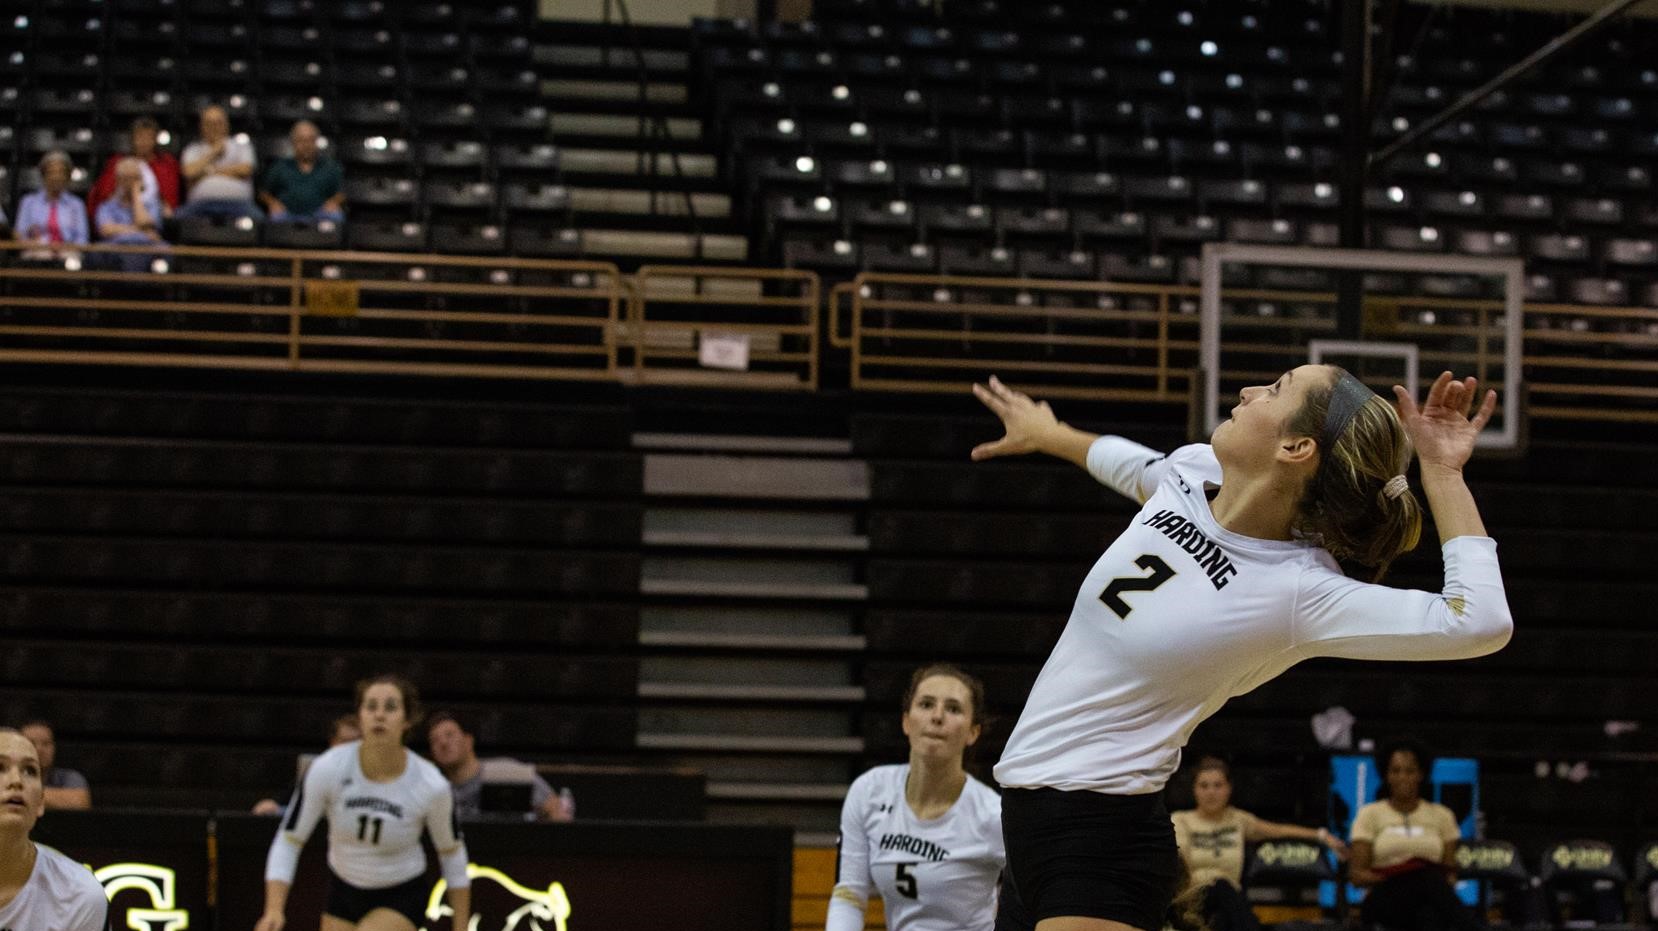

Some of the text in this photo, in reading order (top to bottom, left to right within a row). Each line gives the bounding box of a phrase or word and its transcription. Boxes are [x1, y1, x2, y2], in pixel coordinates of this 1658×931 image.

[1142, 509, 1238, 591] HARDING
[1099, 554, 1176, 620] 2
[358, 815, 382, 844] 11
[895, 862, 918, 900] 5
